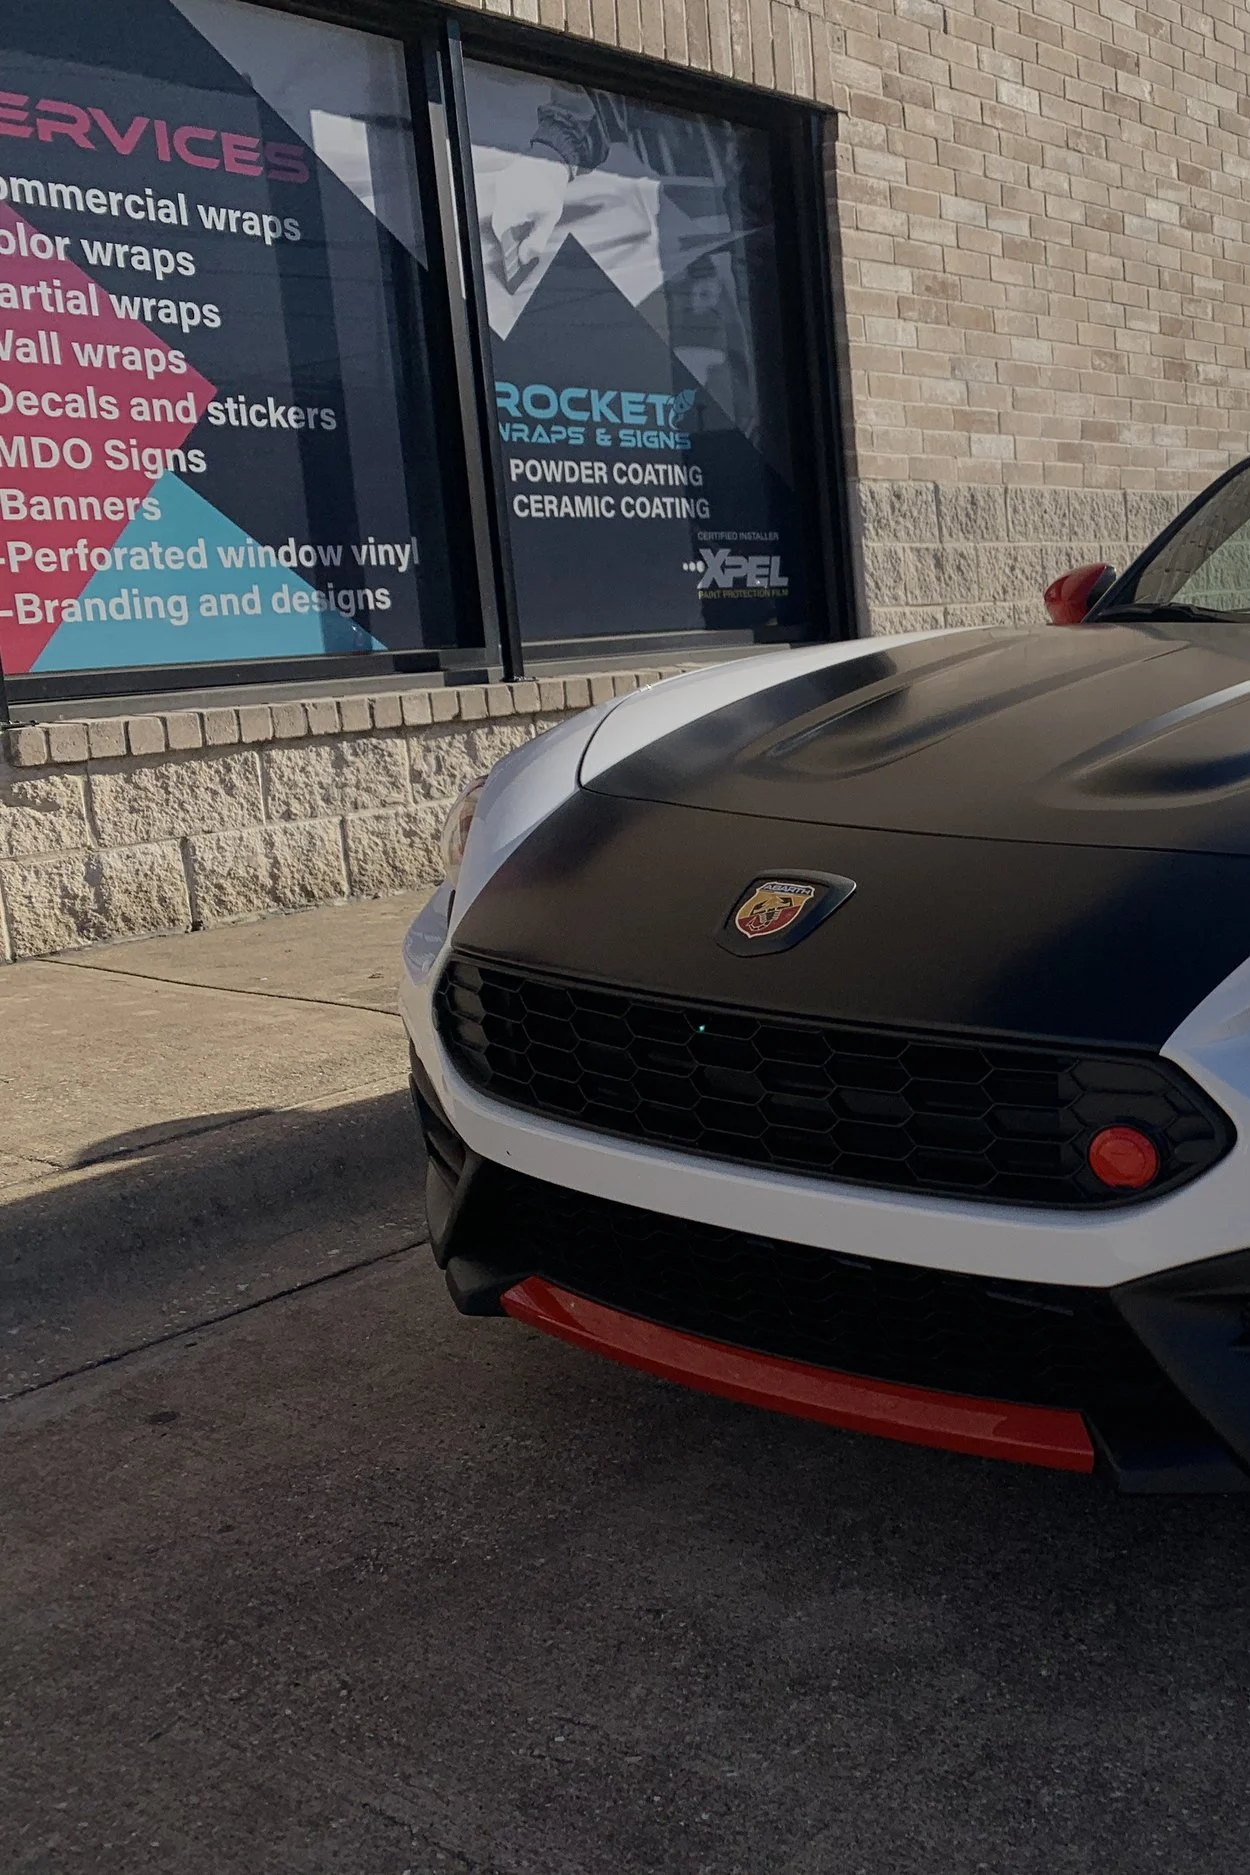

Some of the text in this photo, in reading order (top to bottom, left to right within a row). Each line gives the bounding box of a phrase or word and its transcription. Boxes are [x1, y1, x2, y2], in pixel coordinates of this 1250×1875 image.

[197, 204, 301, 246] wraps
[80, 238, 196, 281] wraps
[109, 293, 221, 333] wraps
[71, 341, 188, 380] wraps
[130, 392, 198, 424] and
[207, 395, 337, 430] stickers
[495, 381, 674, 427] ROCKET
[595, 427, 612, 446] &
[619, 428, 692, 450] SIGNS
[103, 438, 207, 479] Signs
[509, 458, 703, 486] POWDER COATING
[0, 488, 161, 521] Banners
[513, 494, 710, 518] CERAMIC COATING
[697, 531, 779, 540] CERTIFIED INSTALLER
[217, 537, 342, 569] window
[351, 536, 420, 573] vinyl
[697, 548, 789, 589] XPEL
[200, 585, 260, 616] and
[272, 583, 391, 619] designs
[764, 884, 811, 895] ABARTH
